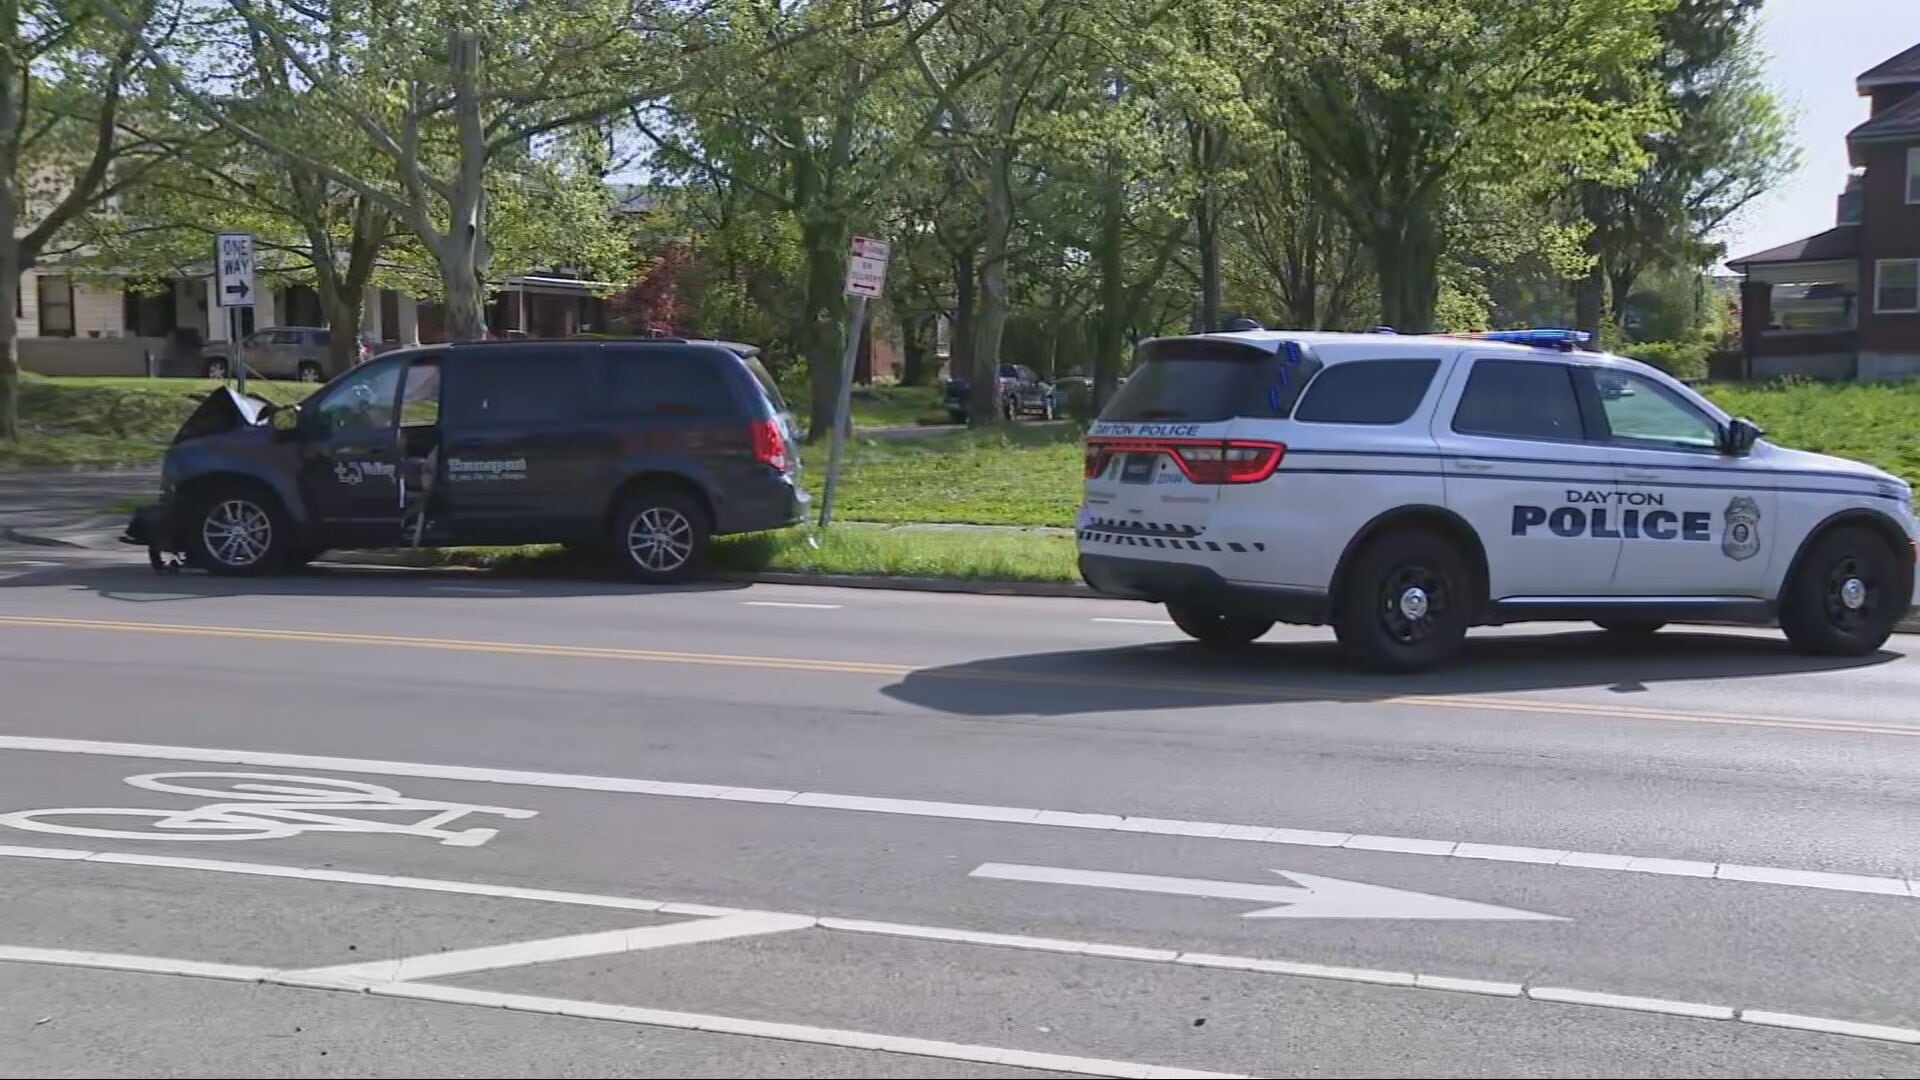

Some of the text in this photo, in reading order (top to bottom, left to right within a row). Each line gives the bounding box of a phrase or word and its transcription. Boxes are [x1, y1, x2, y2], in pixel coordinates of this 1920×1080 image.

[224, 240, 248, 256] ONE
[224, 258, 248, 275] WAY
[1138, 425, 1200, 437] POLICE
[1566, 490, 1664, 506] DAYTON
[1511, 505, 1712, 542] POLICE
